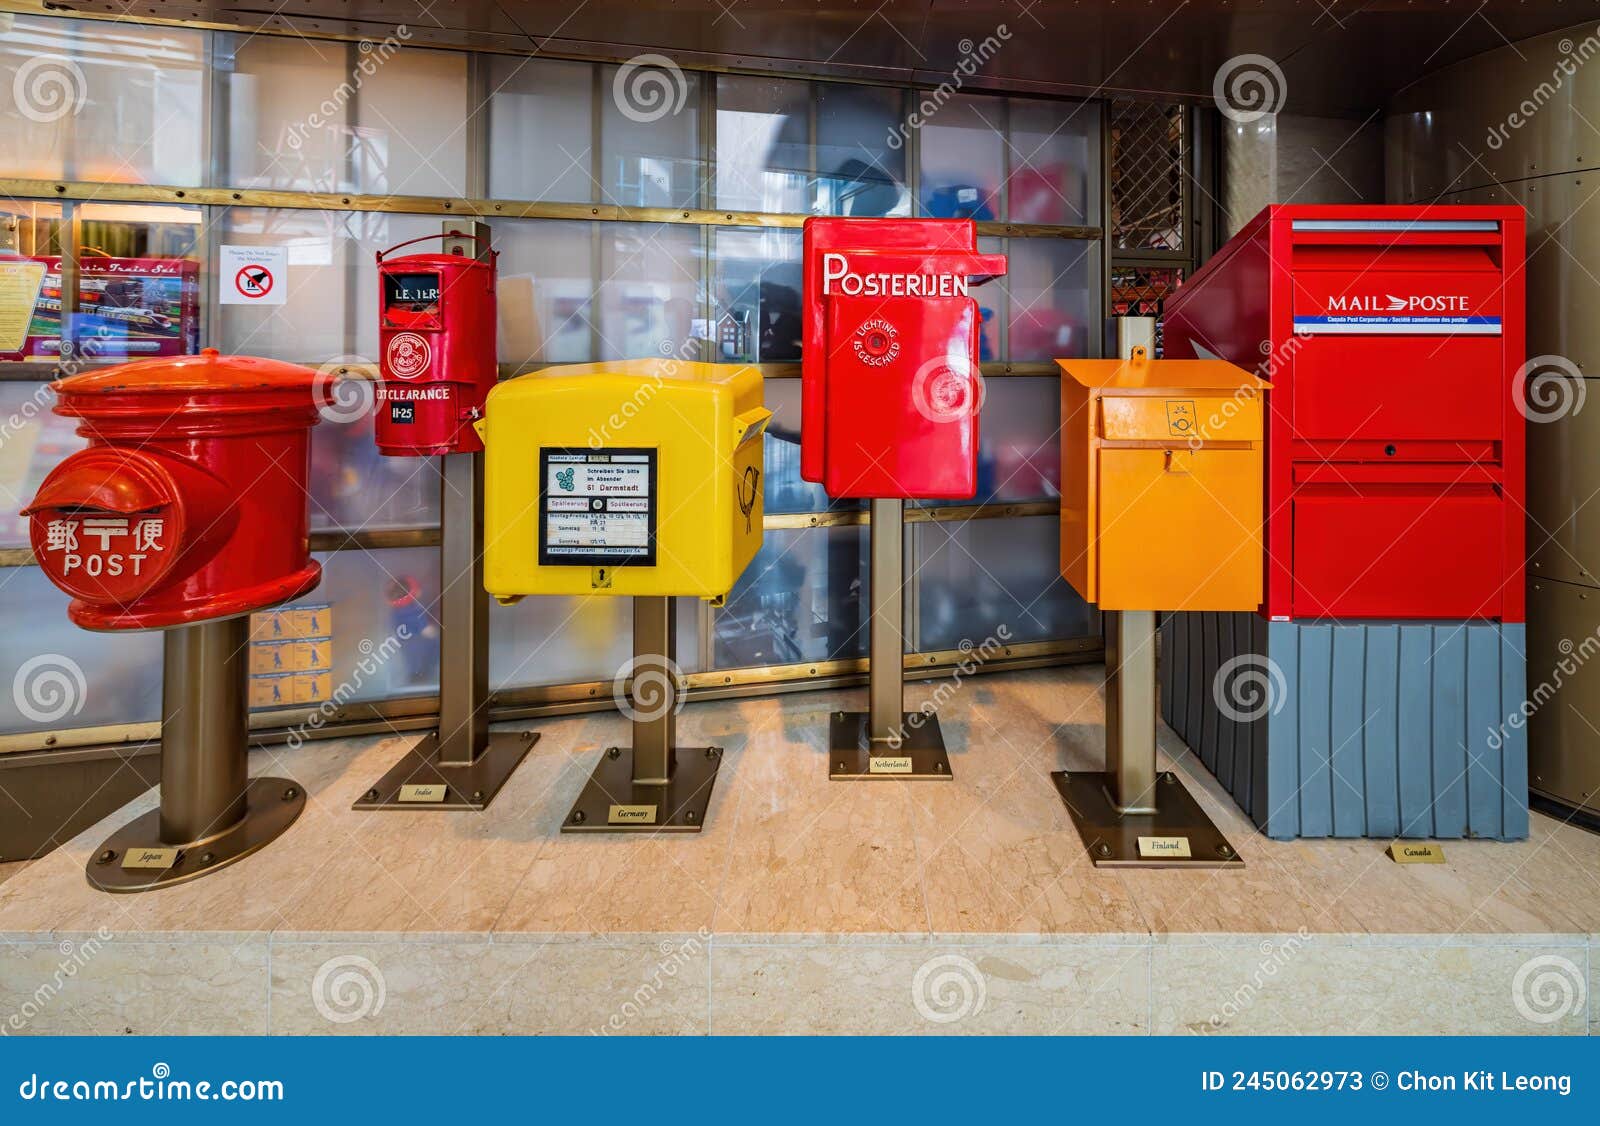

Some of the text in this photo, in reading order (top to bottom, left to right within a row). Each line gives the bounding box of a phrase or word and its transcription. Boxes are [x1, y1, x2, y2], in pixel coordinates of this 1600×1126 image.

[1328, 296, 1470, 311] MAIL POSTE
[856, 319, 897, 337] LICHTING
[853, 340, 900, 367] IS GESCHIED
[388, 388, 450, 400] CLEARANCE
[63, 554, 147, 577] POST
[874, 760, 909, 768] Netherlands
[414, 788, 433, 796] India
[617, 809, 648, 819] Germany
[1151, 840, 1179, 849] Finland
[137, 851, 163, 863] Japan
[1403, 847, 1433, 856] Canada
